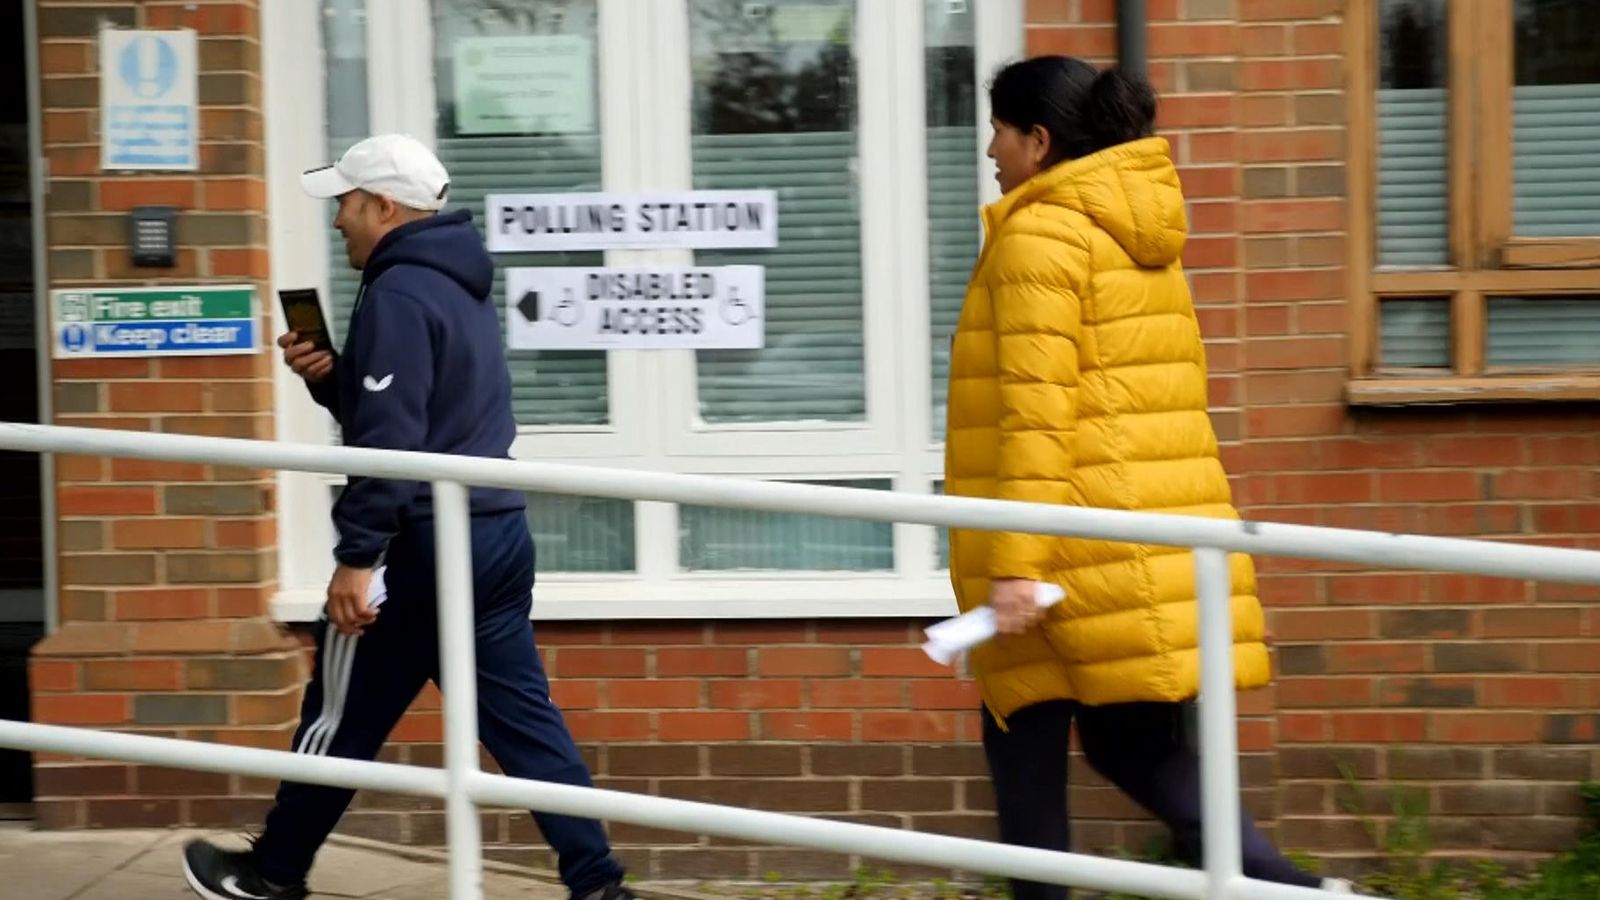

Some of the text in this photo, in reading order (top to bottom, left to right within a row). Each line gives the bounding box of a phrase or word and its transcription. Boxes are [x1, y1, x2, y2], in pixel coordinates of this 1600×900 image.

[500, 202, 763, 234] POLLING STATION
[586, 272, 715, 300] DISABLED
[94, 296, 203, 318] Fire exit
[598, 307, 705, 335] ACCESS
[96, 323, 241, 350] Keep clear
